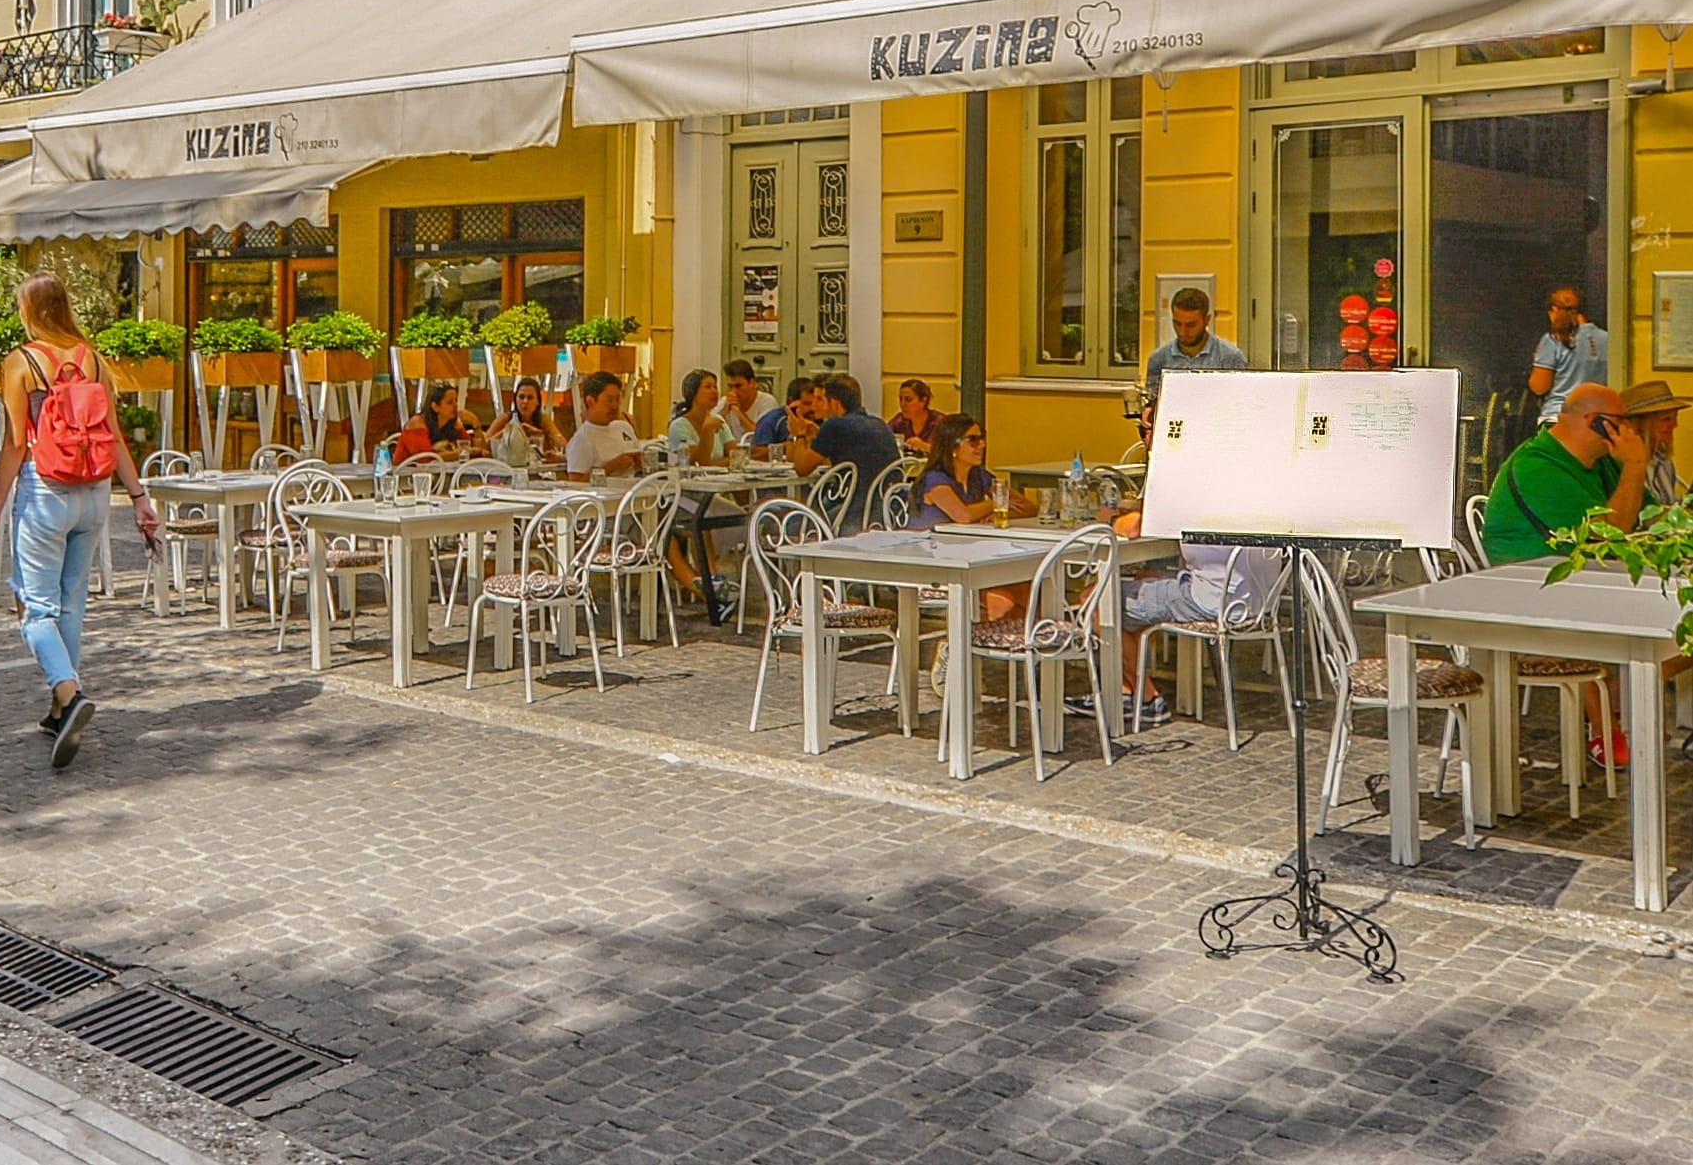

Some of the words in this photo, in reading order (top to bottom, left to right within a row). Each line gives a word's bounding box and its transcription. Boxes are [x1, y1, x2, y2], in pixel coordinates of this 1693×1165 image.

[1112, 39, 1138, 54] 210
[1141, 32, 1204, 51] 3240133
[914, 224, 921, 235] 9
